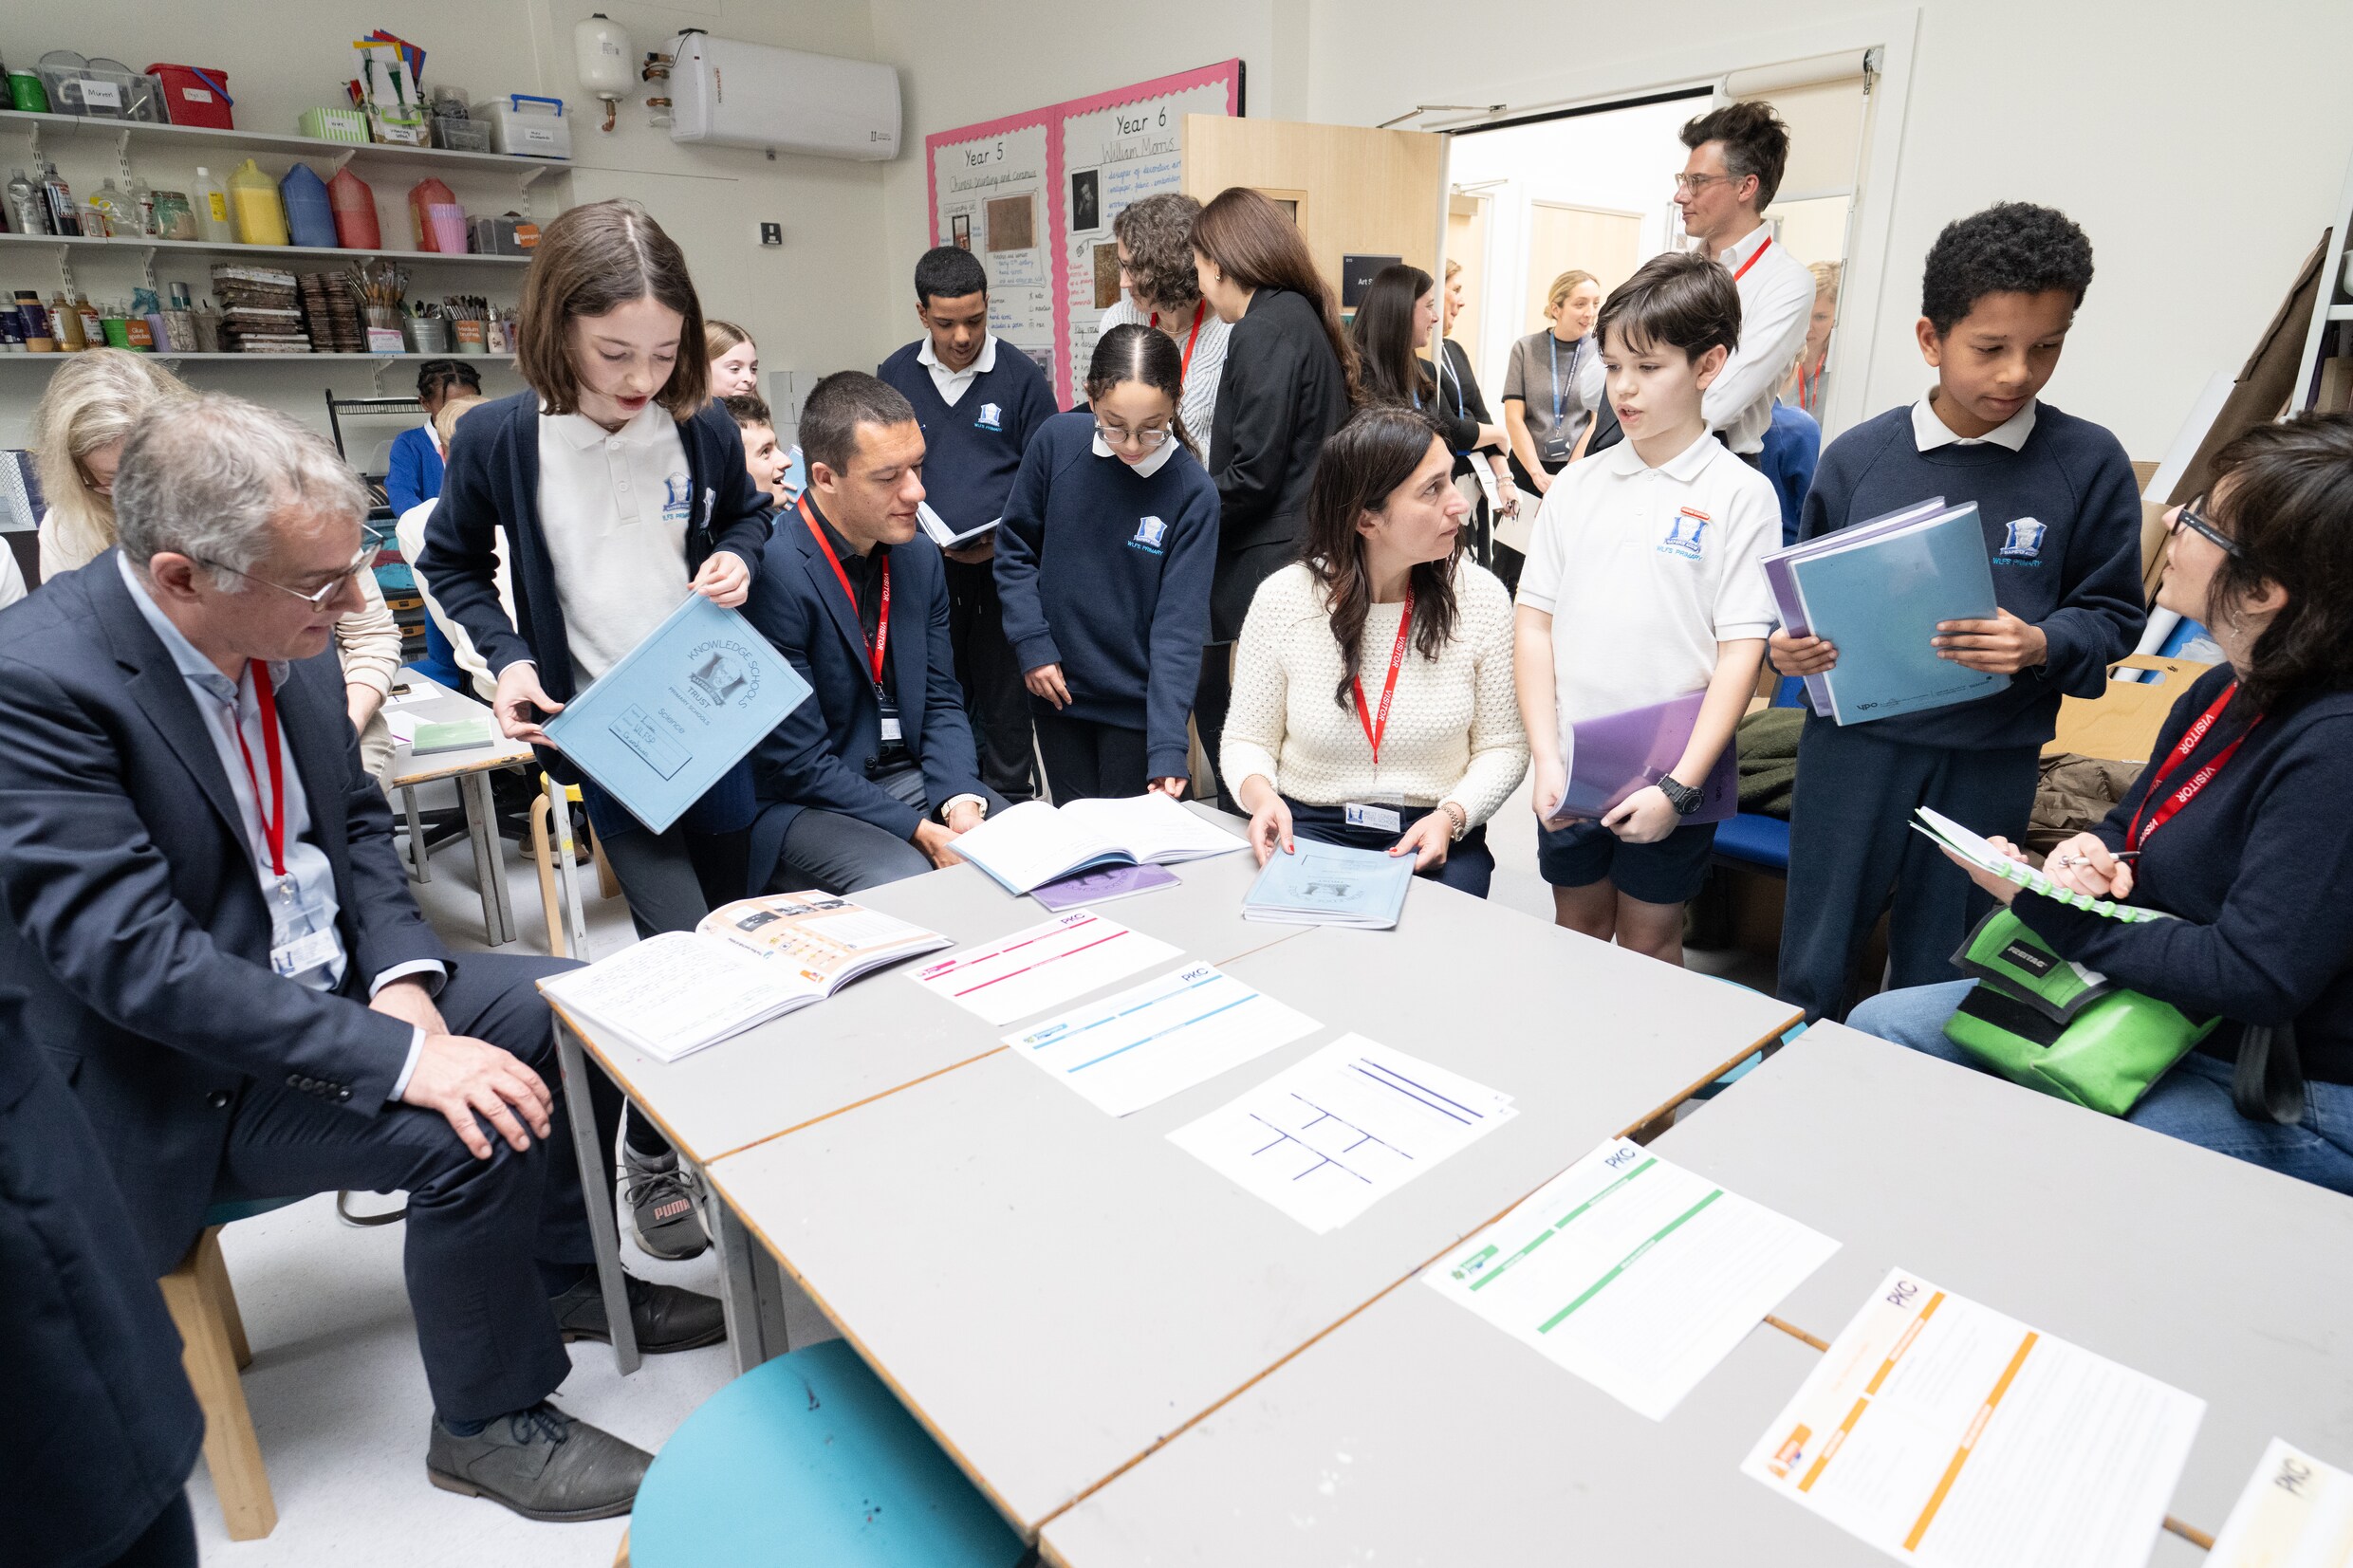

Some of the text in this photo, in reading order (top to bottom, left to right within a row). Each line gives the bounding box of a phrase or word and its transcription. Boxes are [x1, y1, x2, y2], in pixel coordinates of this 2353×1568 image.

[1116, 106, 1166, 136] Year 6
[965, 142, 1004, 167] Year 5
[1102, 137, 1175, 163] William Morris
[1141, 544, 1164, 556] PRIMARY
[1676, 548, 1704, 561] PRIMARY
[1992, 557, 2043, 567] WLFS PRIMARY
[882, 572, 891, 602] VISITOR
[877, 621, 887, 651] VISITOR
[1392, 636, 1406, 669] VISITOR
[687, 639, 761, 710] KNOWLEDGE SCHOOLS
[667, 686, 712, 727] PRIMARY SCHOOLS
[687, 686, 712, 709] TRUST
[1379, 690, 1393, 722] VISITOR
[1856, 702, 1880, 711] ypo
[658, 708, 685, 734] Science
[2177, 713, 2215, 755] VISITOR
[2175, 766, 2216, 803] VISITOR
[1378, 811, 1399, 822] LONDON
[1379, 817, 1399, 827] SCHOOL
[1060, 913, 1085, 925] PKC
[2007, 946, 2045, 968] FREITAG
[1181, 968, 1209, 982] PKC
[1604, 1147, 1636, 1170] PKC
[655, 1198, 691, 1221] PUMA
[1886, 1281, 1918, 1309] PKC
[2274, 1458, 2313, 1497] PKC
